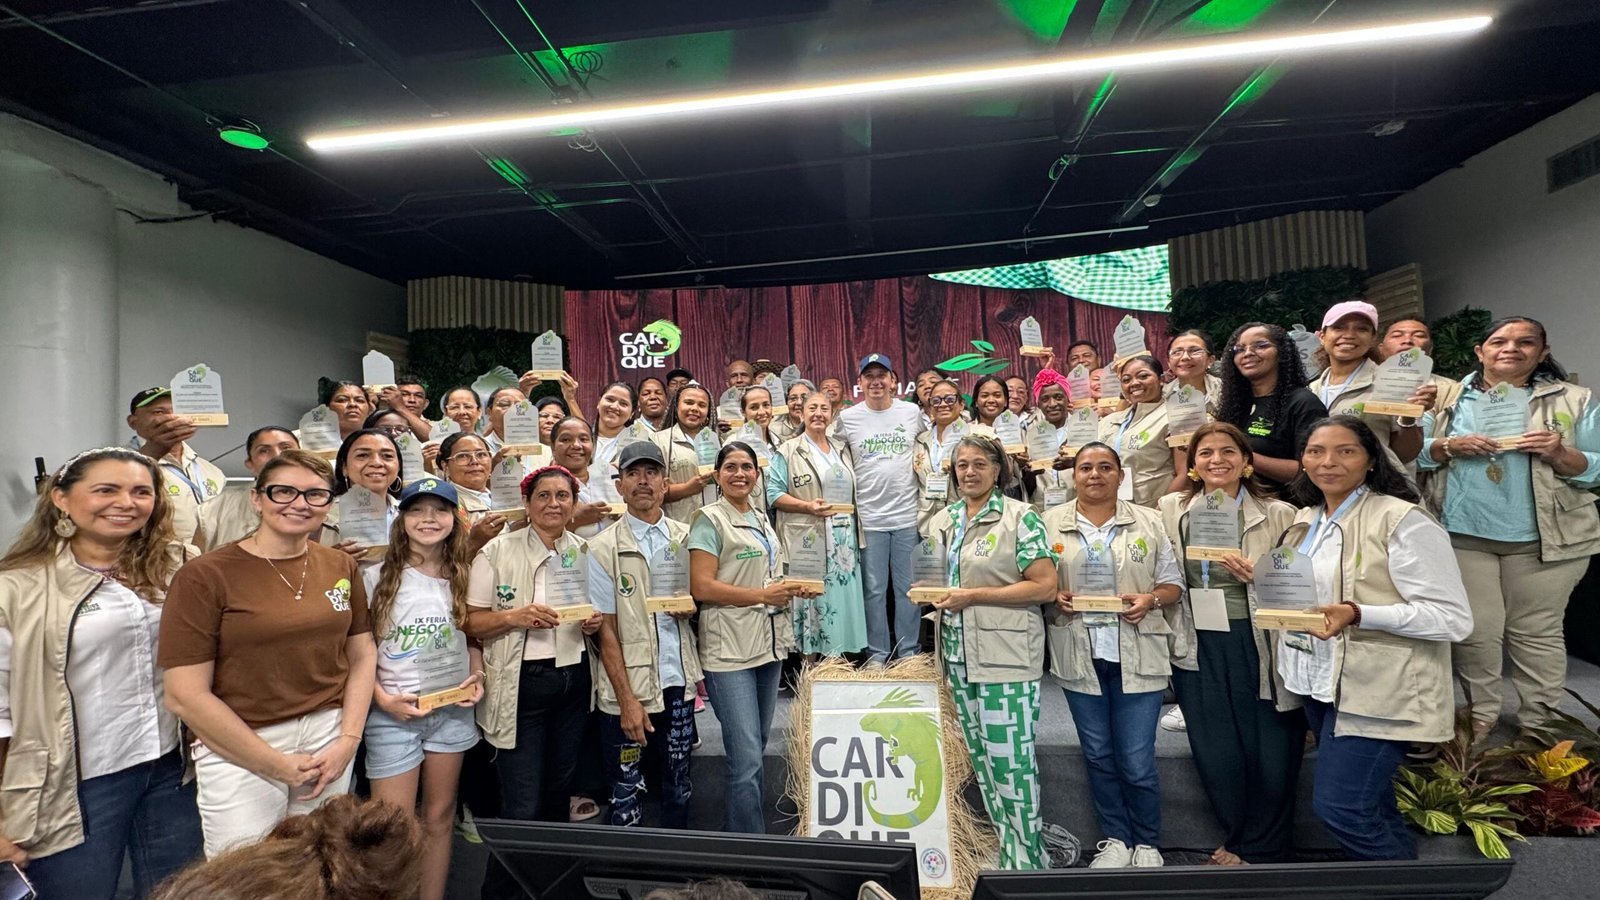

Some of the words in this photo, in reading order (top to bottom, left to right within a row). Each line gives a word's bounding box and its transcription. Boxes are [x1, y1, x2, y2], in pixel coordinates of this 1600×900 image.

[619, 333, 663, 345] CAR
[622, 345, 646, 356] DI
[621, 356, 665, 368] QUE
[325, 586, 350, 598] CAR
[333, 602, 351, 612] QUE
[811, 736, 904, 778] CAR
[818, 782, 863, 827] DI
